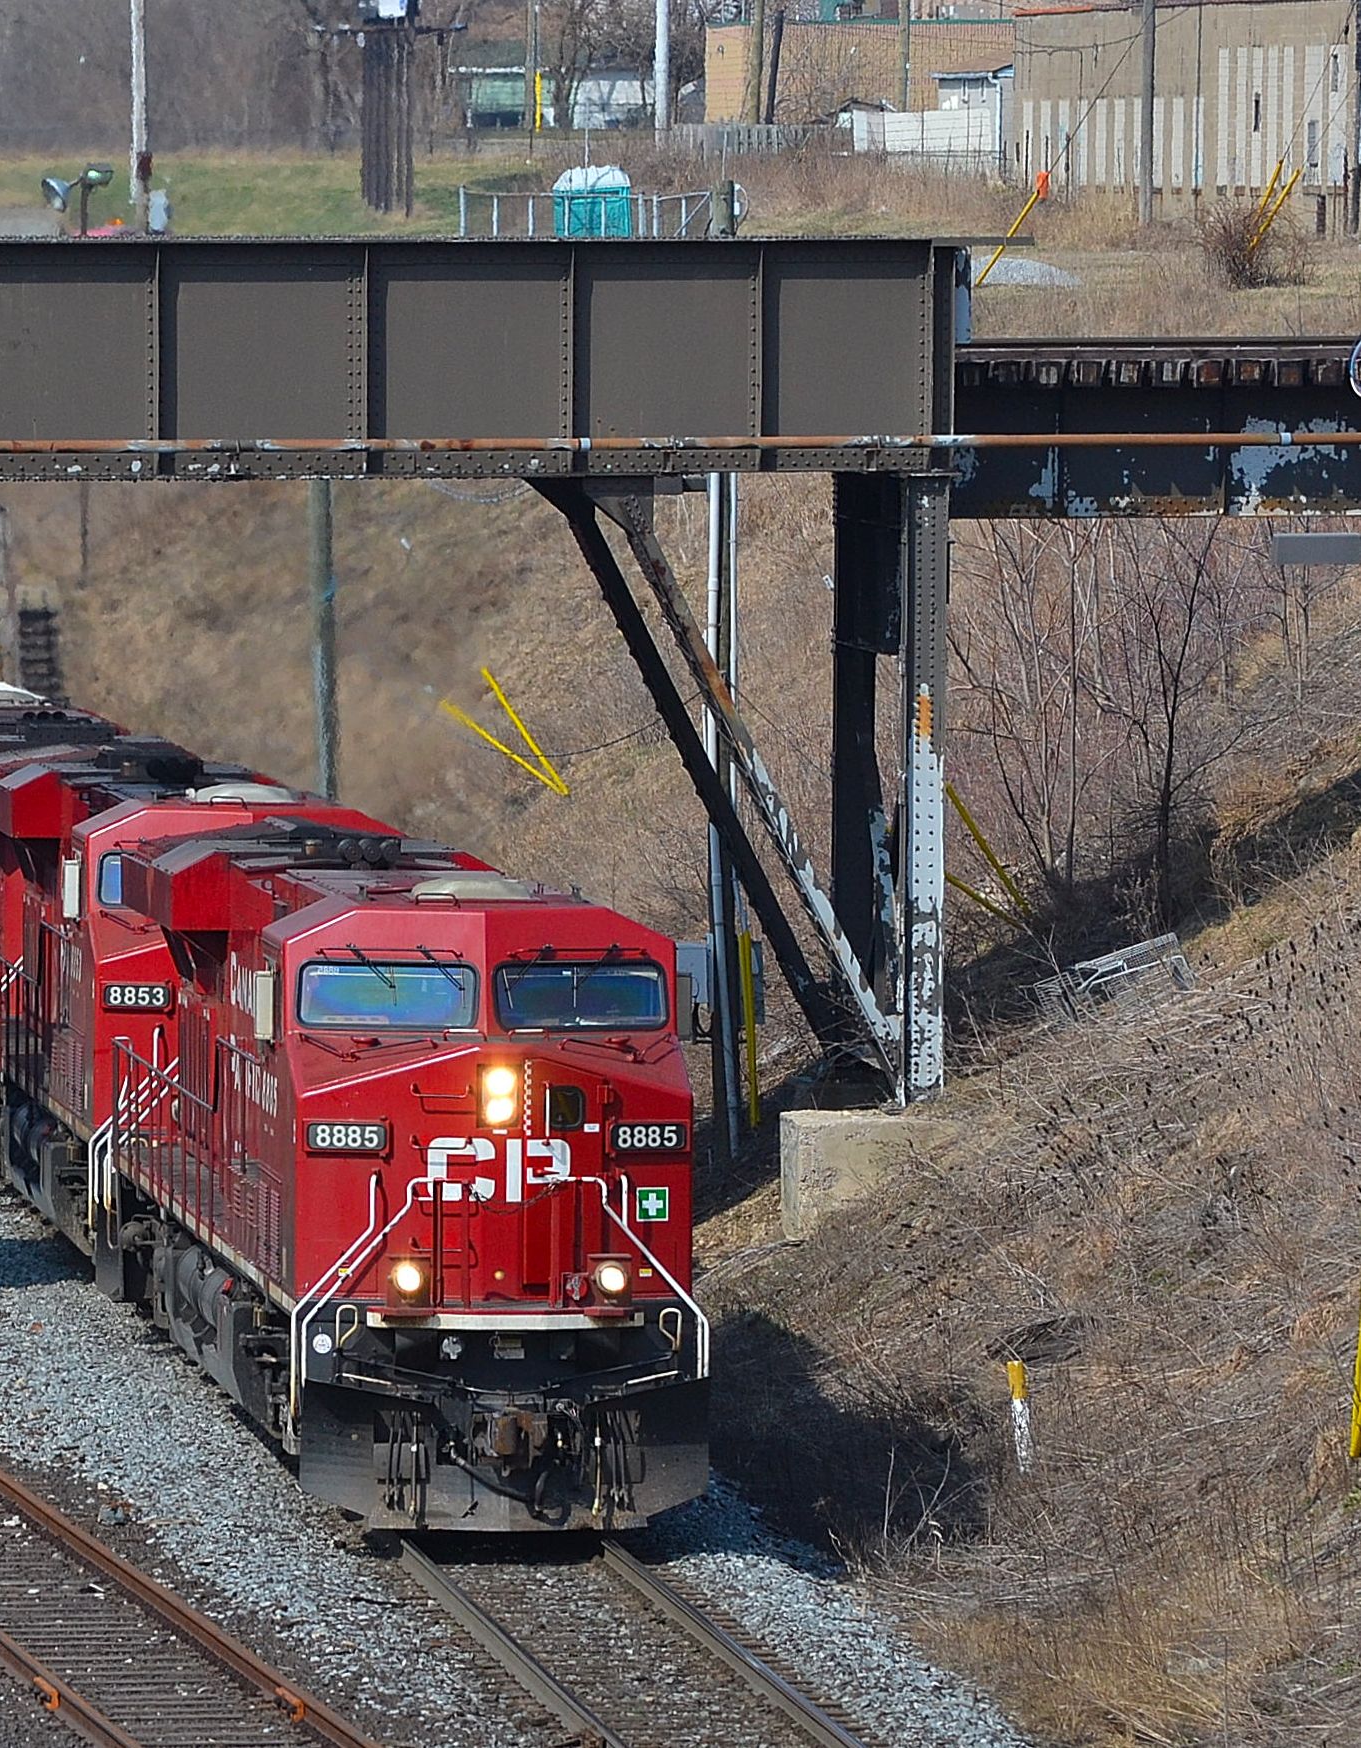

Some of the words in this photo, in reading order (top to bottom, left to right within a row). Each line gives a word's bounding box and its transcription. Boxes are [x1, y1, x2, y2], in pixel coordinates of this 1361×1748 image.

[109, 986, 165, 1005] 8853
[315, 1124, 379, 1148] 8885
[617, 1126, 678, 1148] 8885
[427, 1137, 571, 1203] CP
